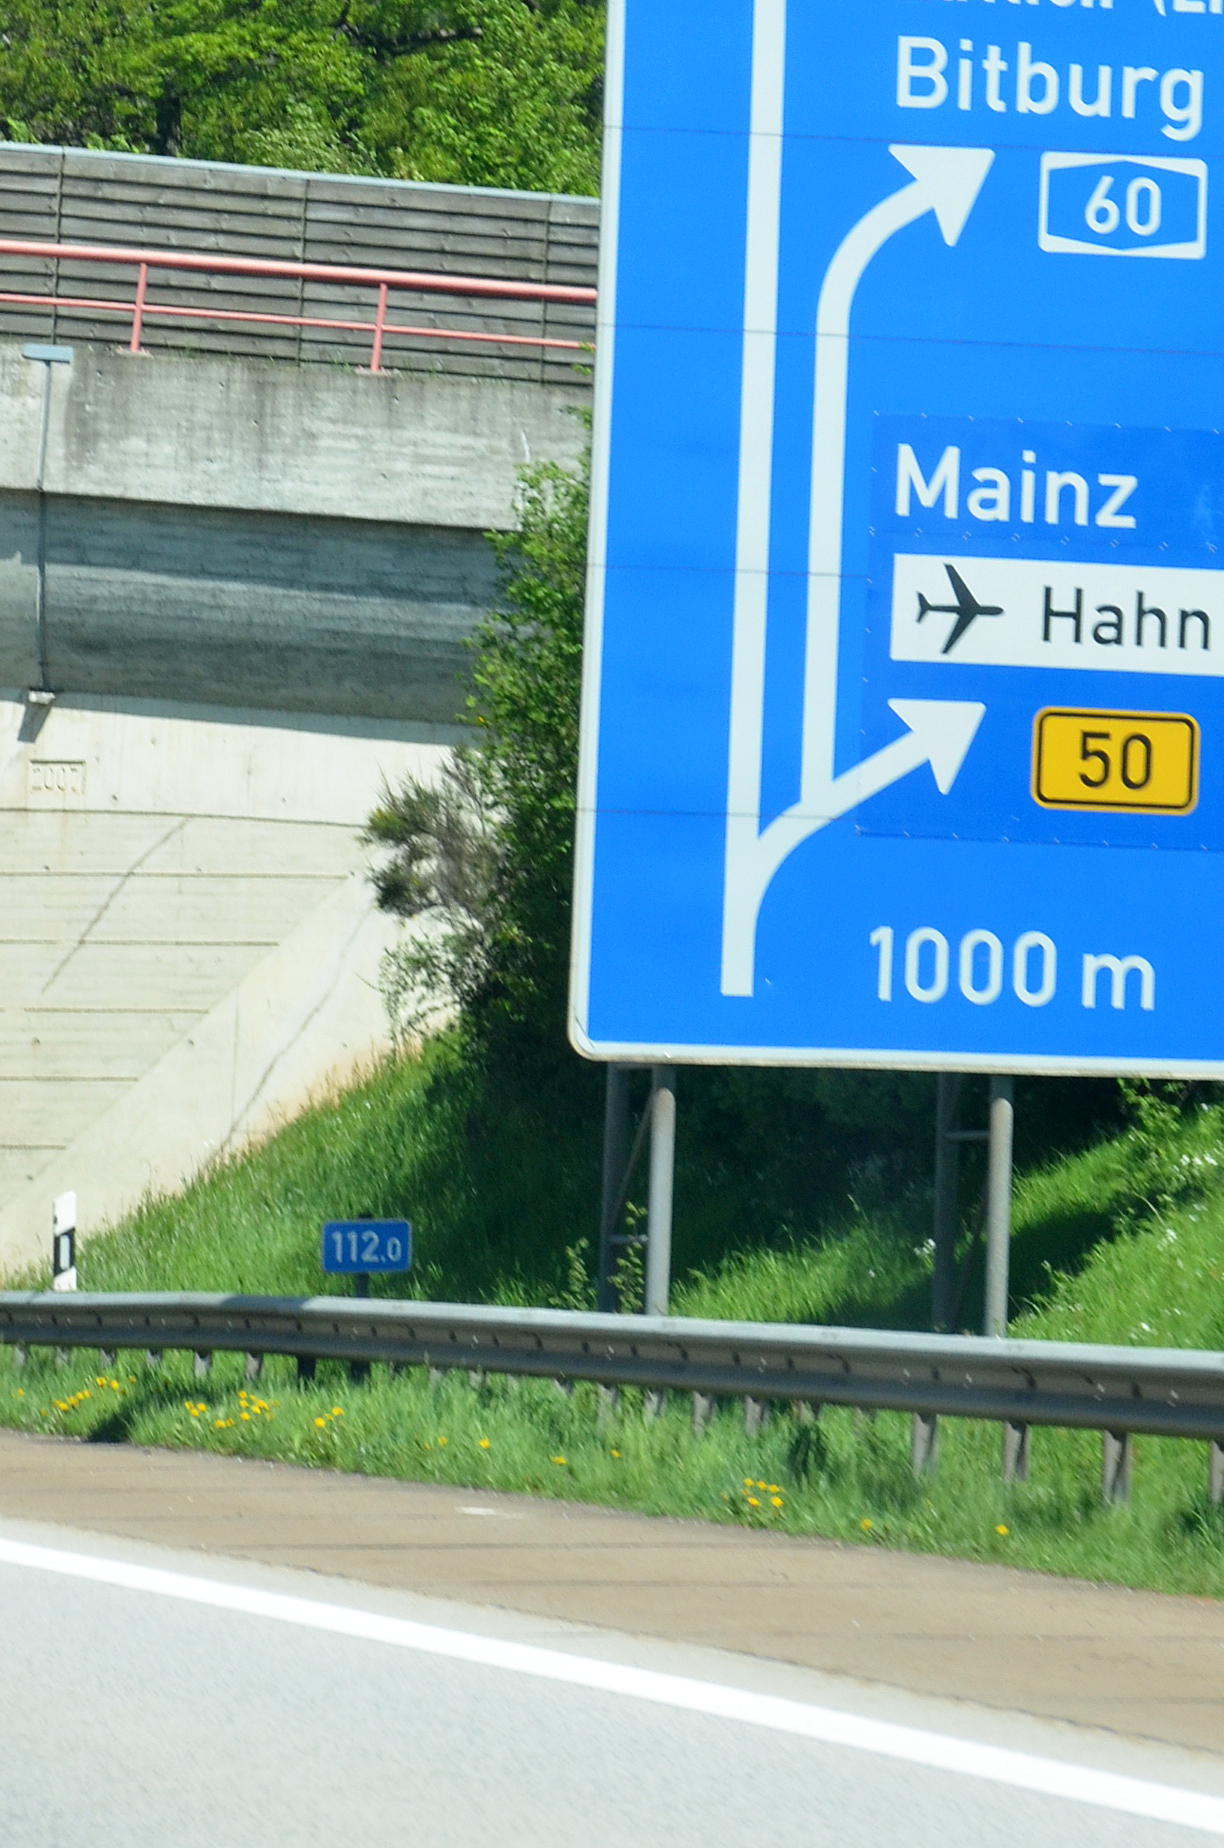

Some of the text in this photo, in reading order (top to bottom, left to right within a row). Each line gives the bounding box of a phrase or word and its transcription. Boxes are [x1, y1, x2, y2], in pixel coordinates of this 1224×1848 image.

[895, 34, 1205, 142] Bitburg
[1084, 174, 1163, 237] 60
[894, 442, 1138, 530] Mainz
[1042, 585, 1212, 650] Hahn
[1079, 730, 1153, 791] 50
[868, 925, 1156, 1012] 1000 m
[332, 1230, 402, 1263] 112.0
